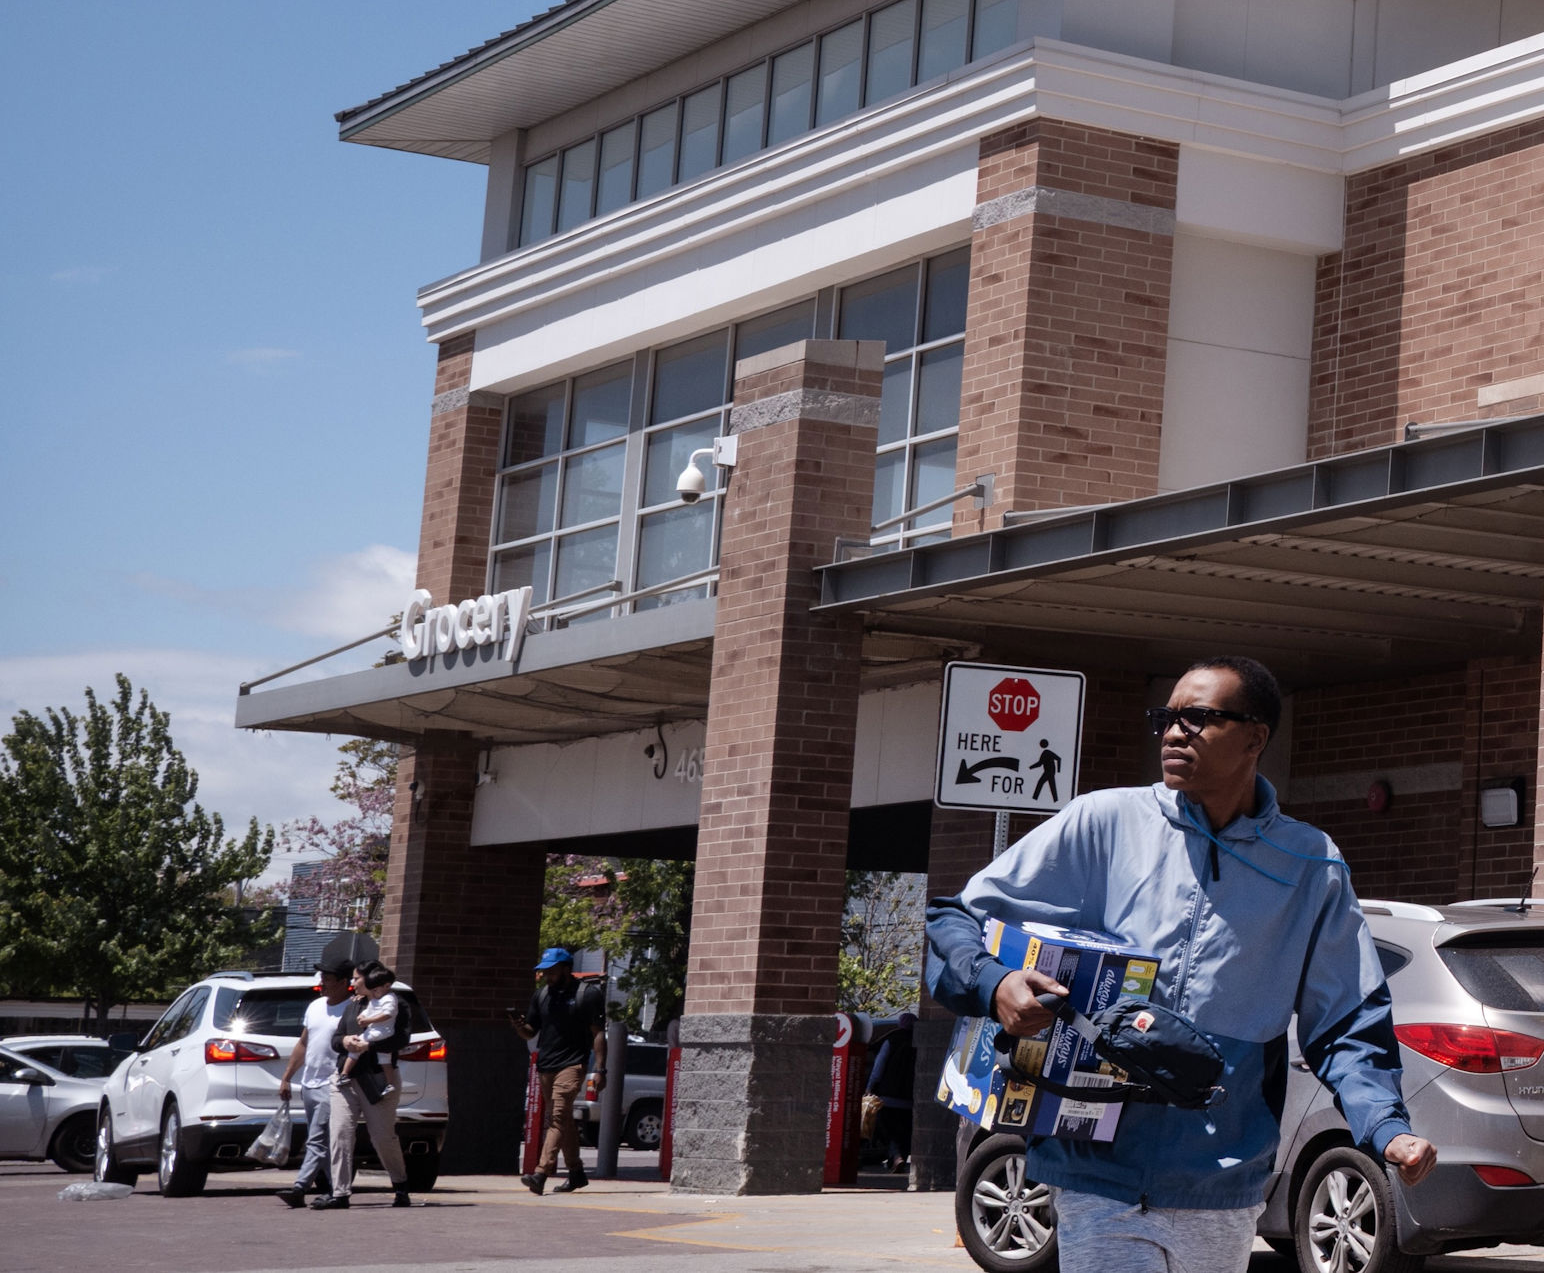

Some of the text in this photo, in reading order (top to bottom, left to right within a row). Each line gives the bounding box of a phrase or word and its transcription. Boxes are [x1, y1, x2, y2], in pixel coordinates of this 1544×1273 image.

[401, 585, 533, 662] Grocery
[990, 693, 1039, 716] STOP
[957, 732, 1002, 753] HERE
[991, 775, 1024, 795] FOR
[1097, 969, 1114, 1010] always
[1056, 1025, 1078, 1065] lways
